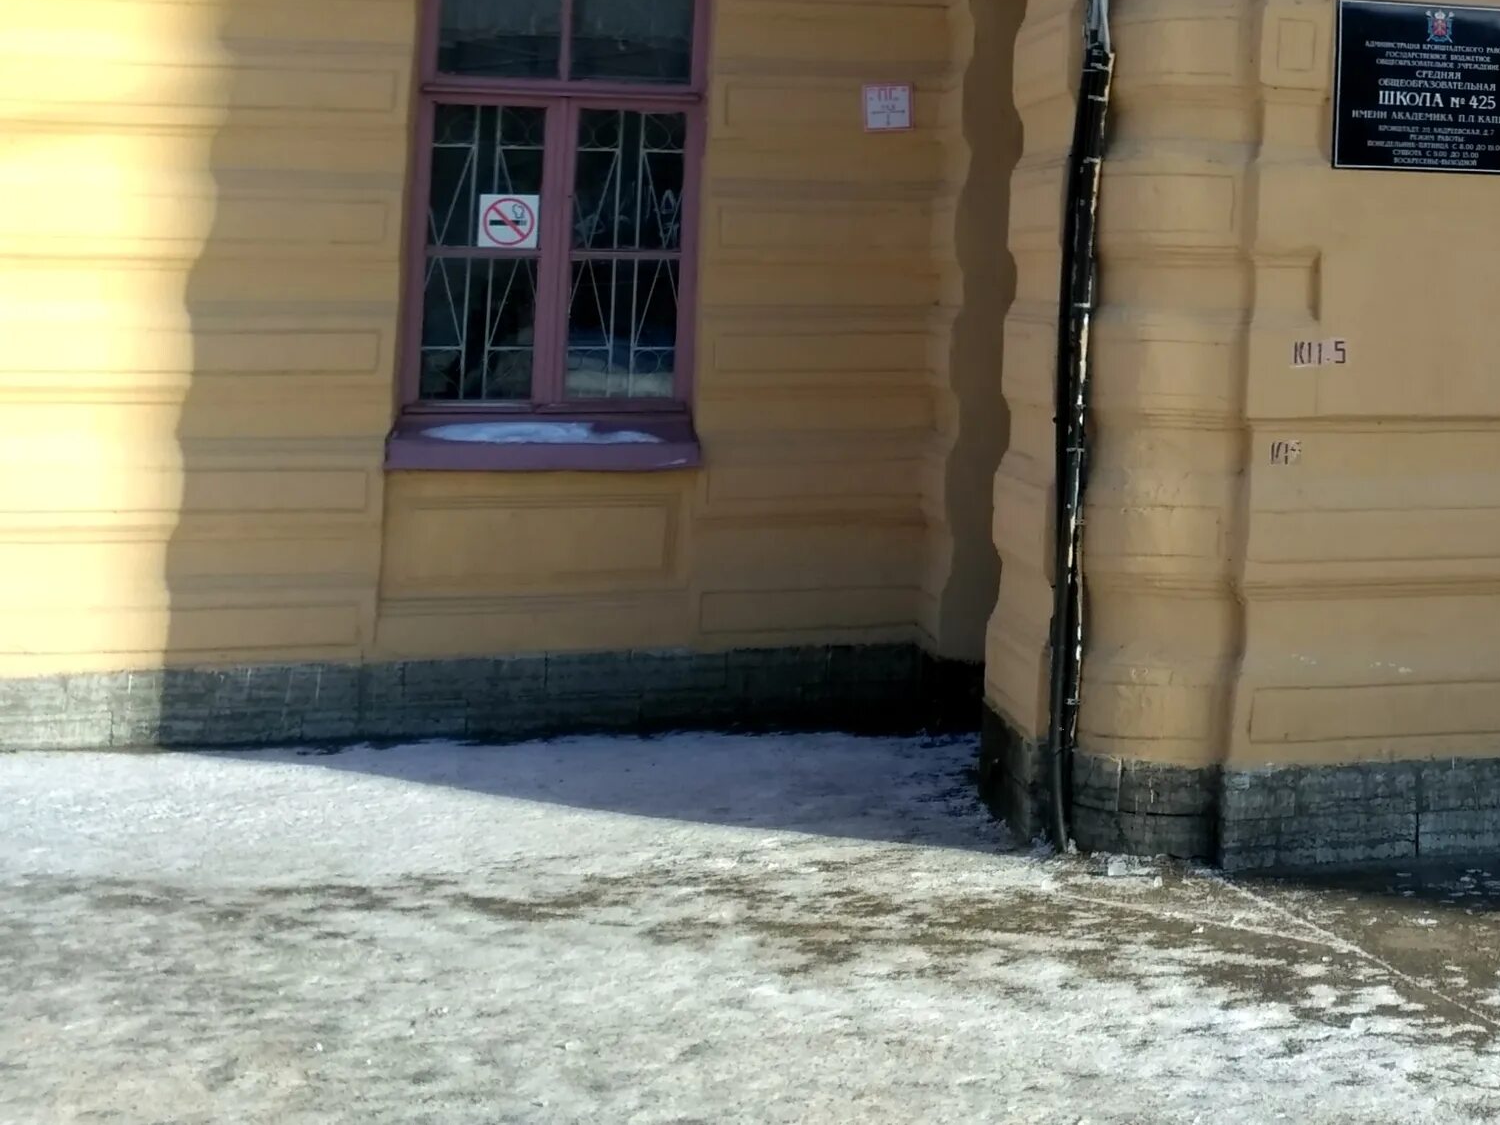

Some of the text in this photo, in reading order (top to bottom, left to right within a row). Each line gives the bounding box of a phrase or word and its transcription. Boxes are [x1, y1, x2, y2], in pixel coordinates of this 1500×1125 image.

[1416, 70, 1461, 80] СРЕДНЯЯ
[1378, 78, 1496, 91] ОБЩЕОБРАЗОВАТЕЛЬНАЯ
[1379, 90, 1496, 110] ШКОЛА № 425
[1352, 109, 1388, 119] ИМЕНИ
[1391, 111, 1453, 122] АКАДЕМИКА
